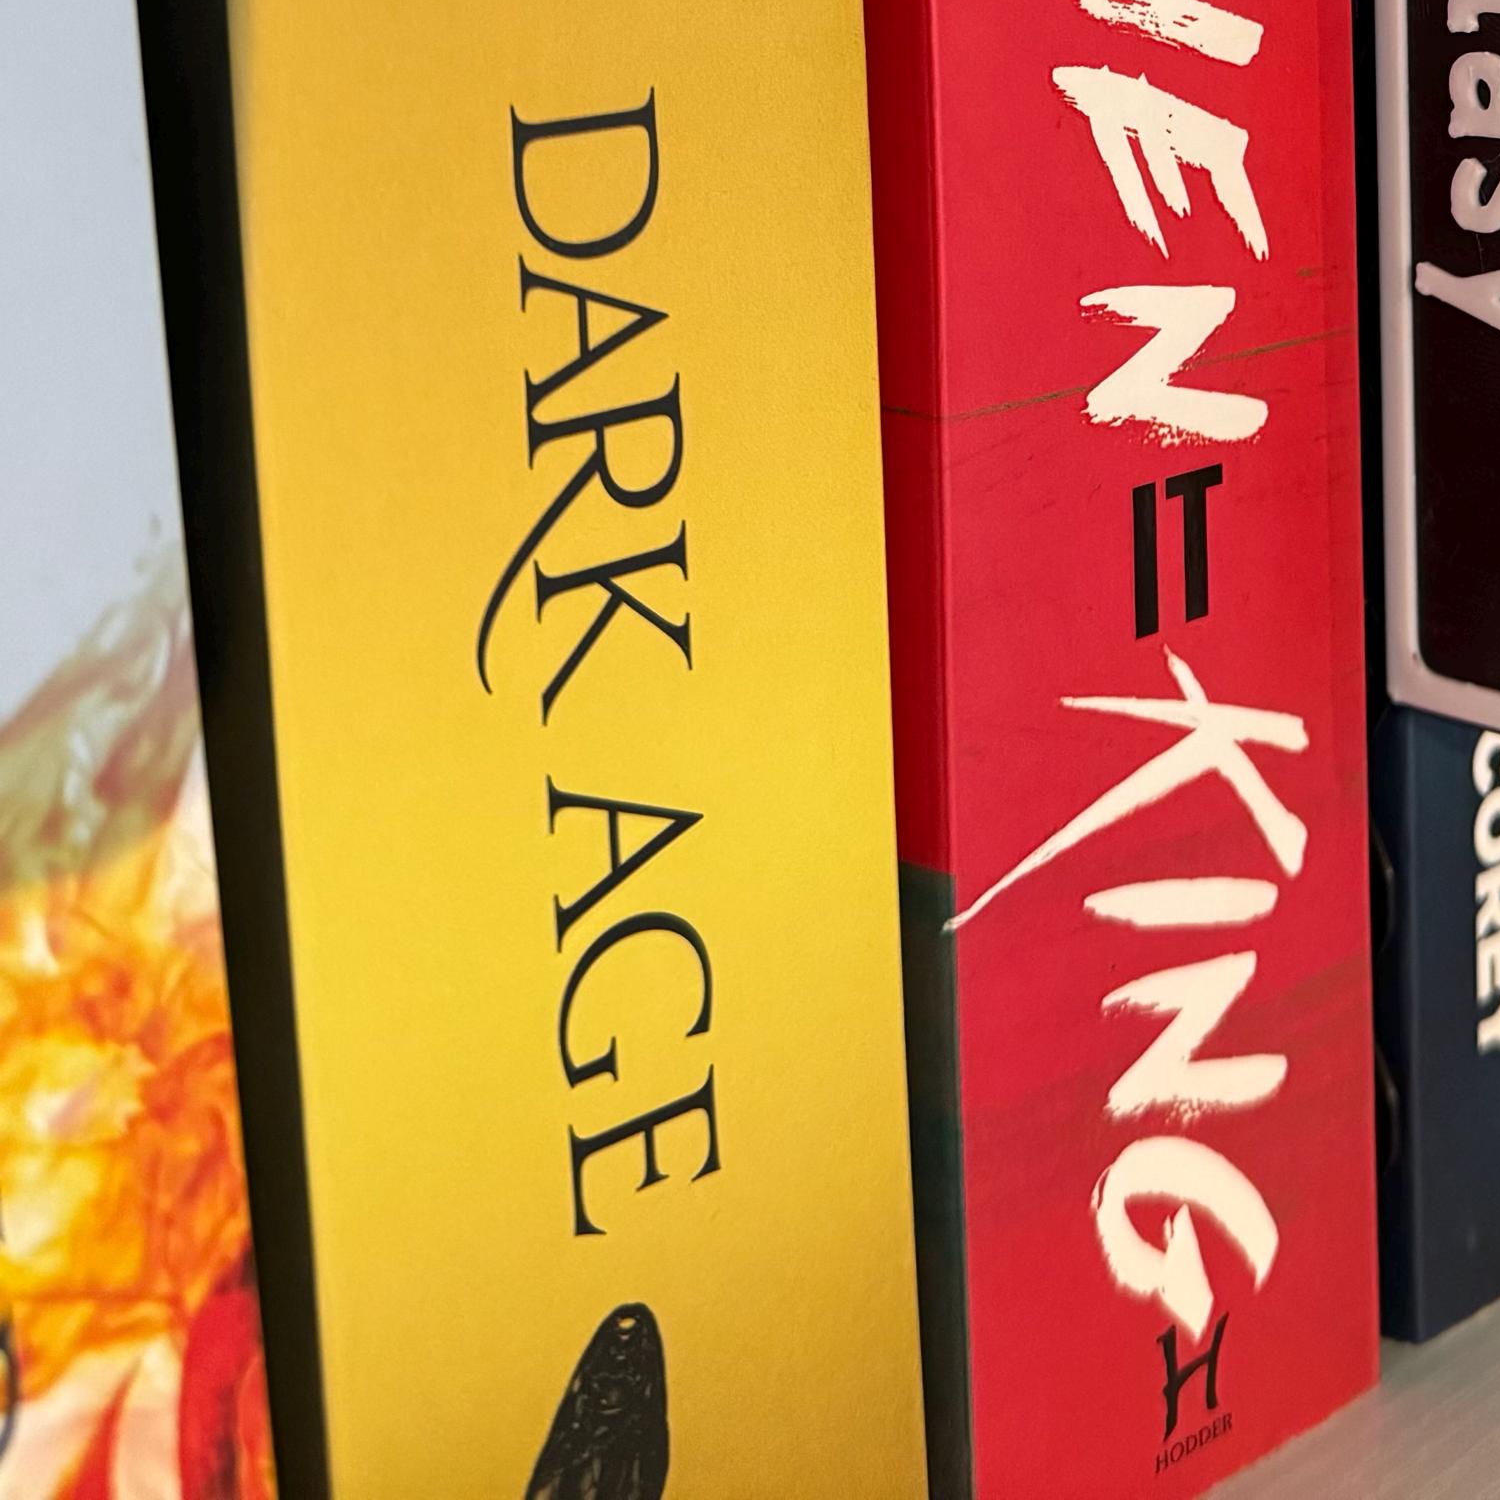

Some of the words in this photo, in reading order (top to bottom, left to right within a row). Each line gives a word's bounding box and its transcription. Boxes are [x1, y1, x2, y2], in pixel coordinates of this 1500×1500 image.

[477, 86, 693, 726] DARK
[1132, 463, 1223, 639] IT
[547, 774, 722, 1238] AGE
[944, 645, 1309, 1341] KING
[1155, 1412, 1233, 1474] HODDER
